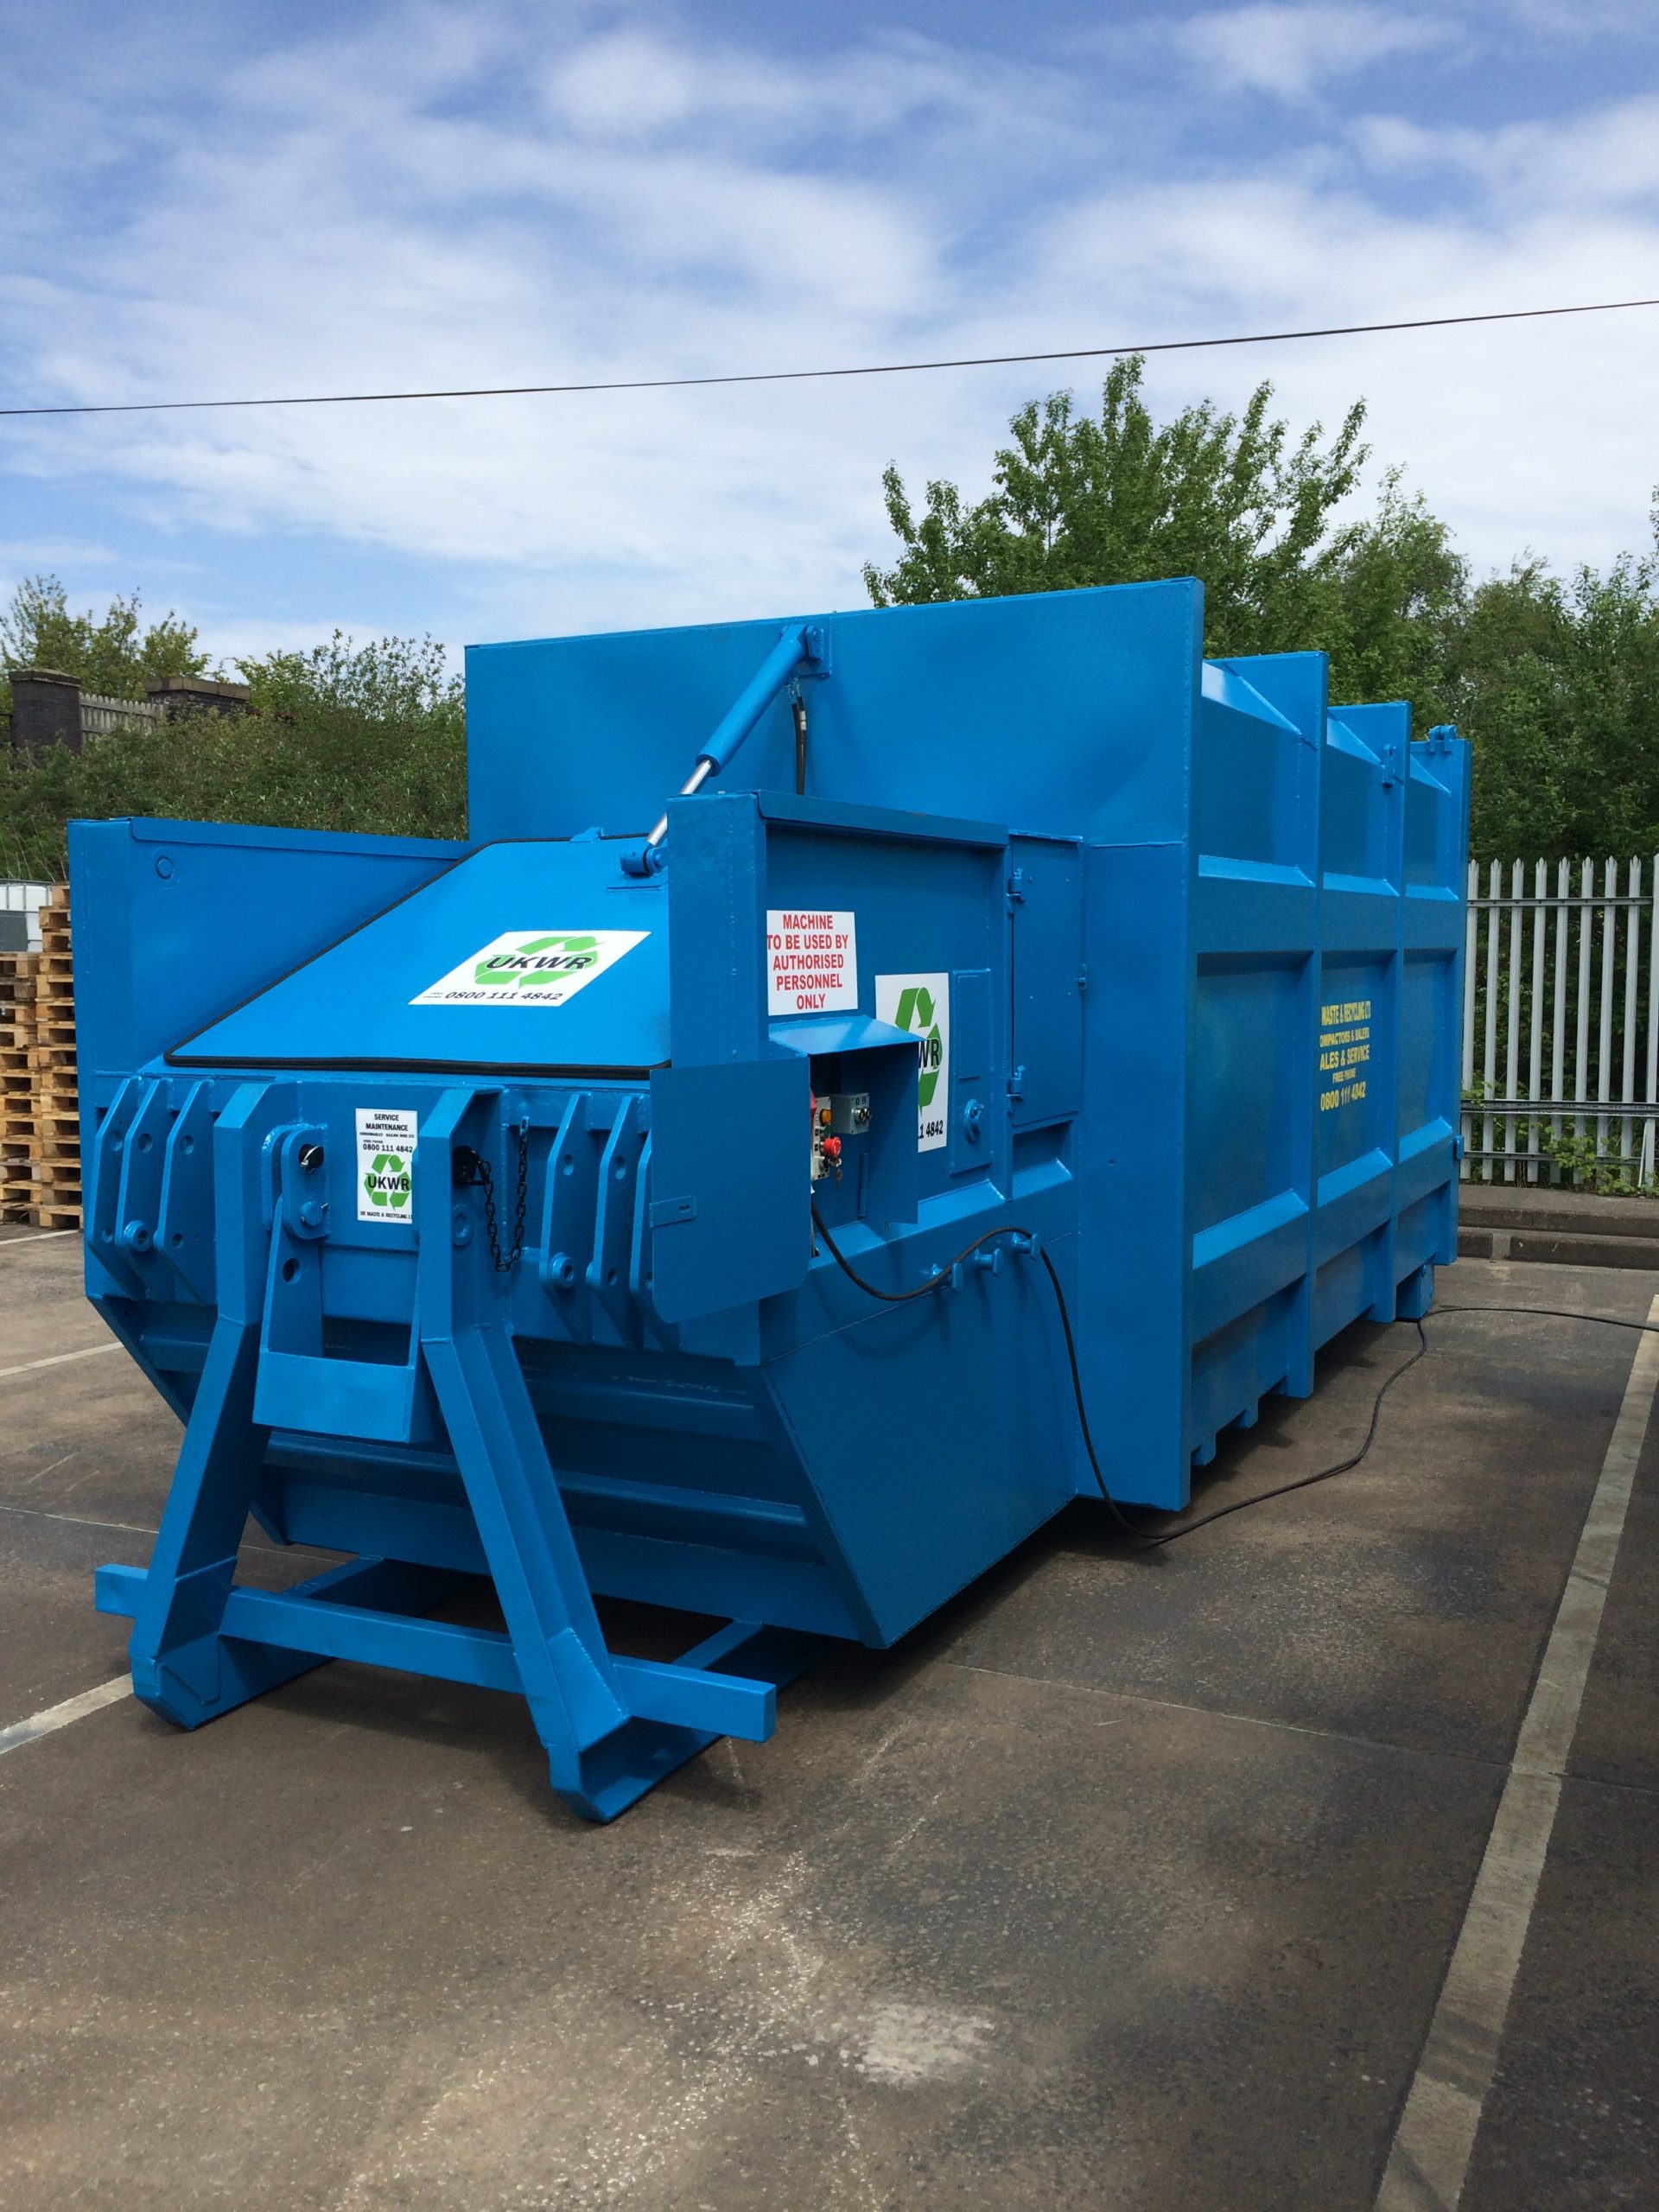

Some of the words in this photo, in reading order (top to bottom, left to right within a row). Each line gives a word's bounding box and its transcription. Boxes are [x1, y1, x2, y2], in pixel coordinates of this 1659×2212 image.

[783, 914, 834, 930] MACHINE
[767, 935, 782, 950] TO
[785, 935, 801, 950] BE
[804, 935, 832, 950] USED
[835, 934, 849, 949] BY
[486, 956, 593, 969] UKWR
[772, 954, 844, 970] AUTHORISED
[776, 973, 842, 991] PERSONNEL
[444, 991, 485, 1000] 0800
[520, 992, 564, 1001] 4842
[796, 994, 826, 1010] ONLY
[1322, 1005, 1339, 1026] WASTE
[1320, 1031, 1350, 1048] OMPACTORS
[918, 1038, 939, 1069] WR
[1319, 1051, 1339, 1071] ALES
[1341, 1049, 1345, 1066] &
[1347, 1044, 1370, 1065] SERVICE
[1320, 1090, 1339, 1111] 0800
[1341, 1085, 1350, 1105] 111
[1351, 1081, 1366, 1101] 4842
[374, 1113, 399, 1122] SERVICE
[365, 1122, 409, 1132] MAINTENANCE
[925, 1119, 944, 1138] 4842
[396, 1145, 413, 1154] 4842
[367, 1175, 410, 1192] UKWR
